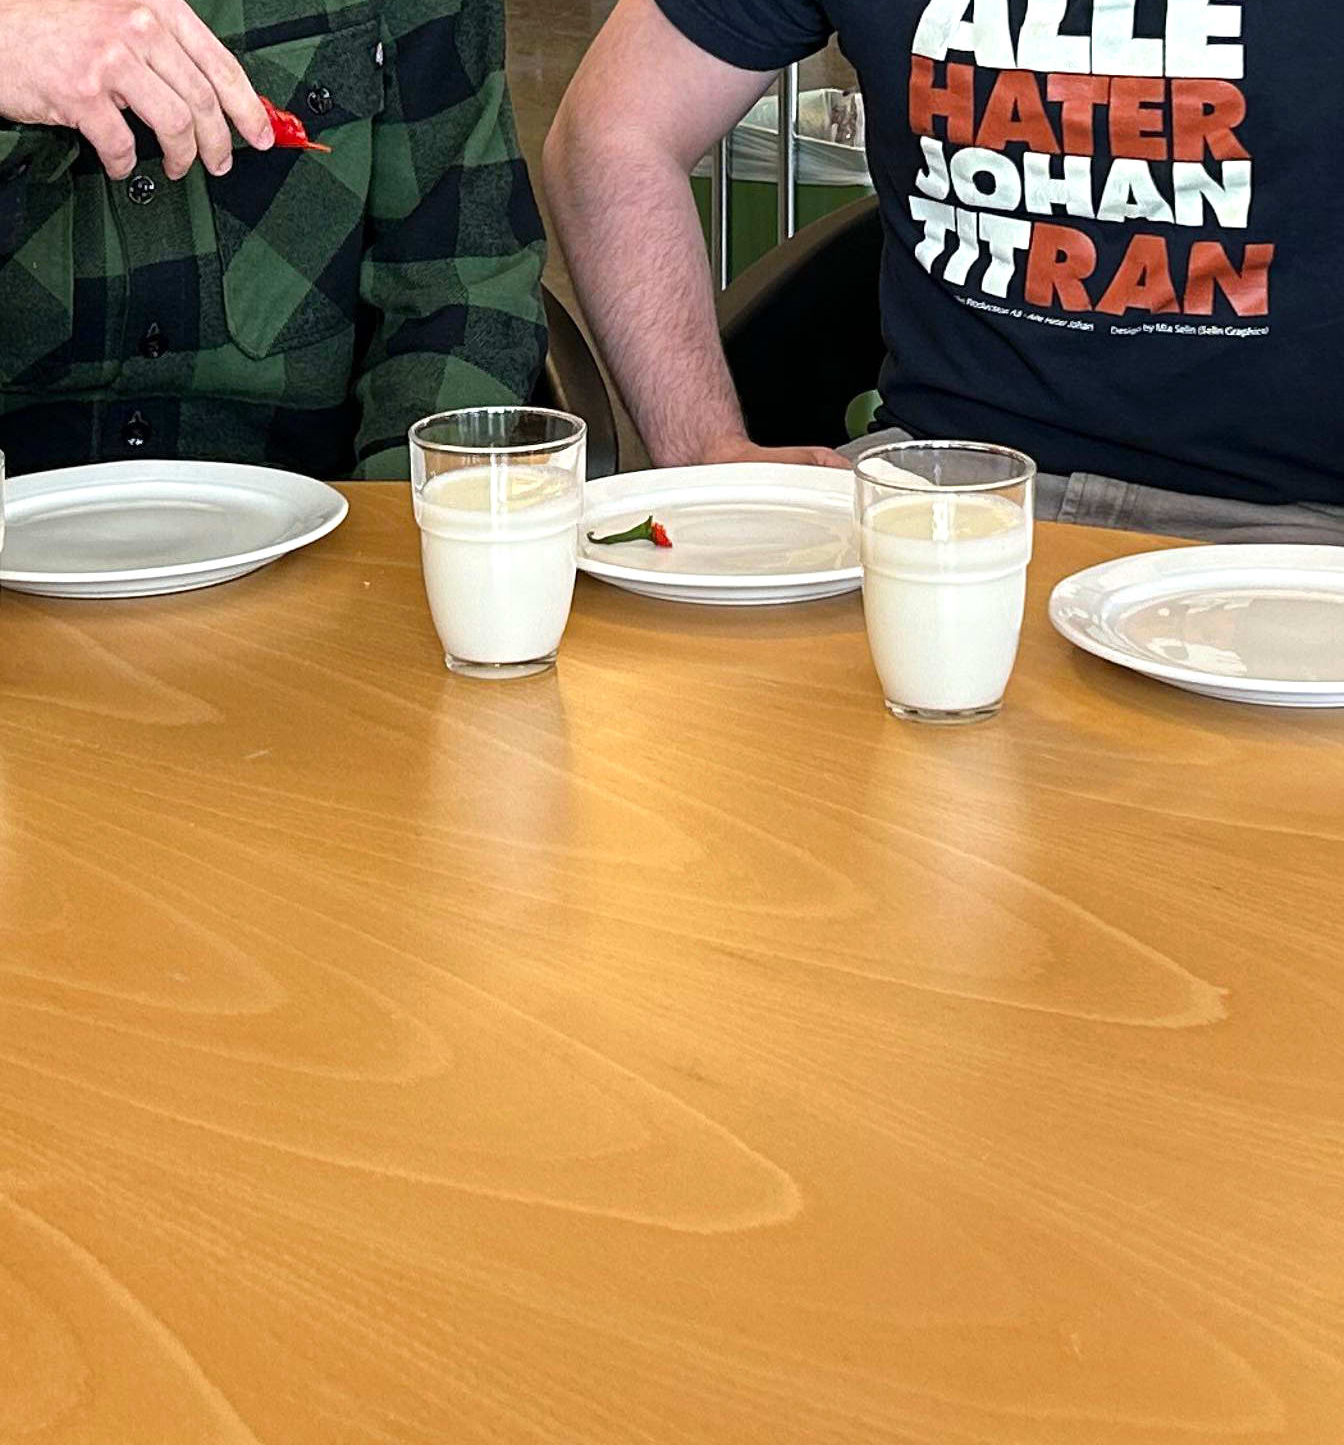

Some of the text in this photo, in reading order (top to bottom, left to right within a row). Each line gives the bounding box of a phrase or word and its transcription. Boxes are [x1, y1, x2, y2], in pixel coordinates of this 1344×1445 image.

[909, 55, 1252, 161] HATER
[915, 136, 1251, 228] JOHAN
[908, 195, 1275, 317] TITRAN
[1142, 323, 1154, 334] by
